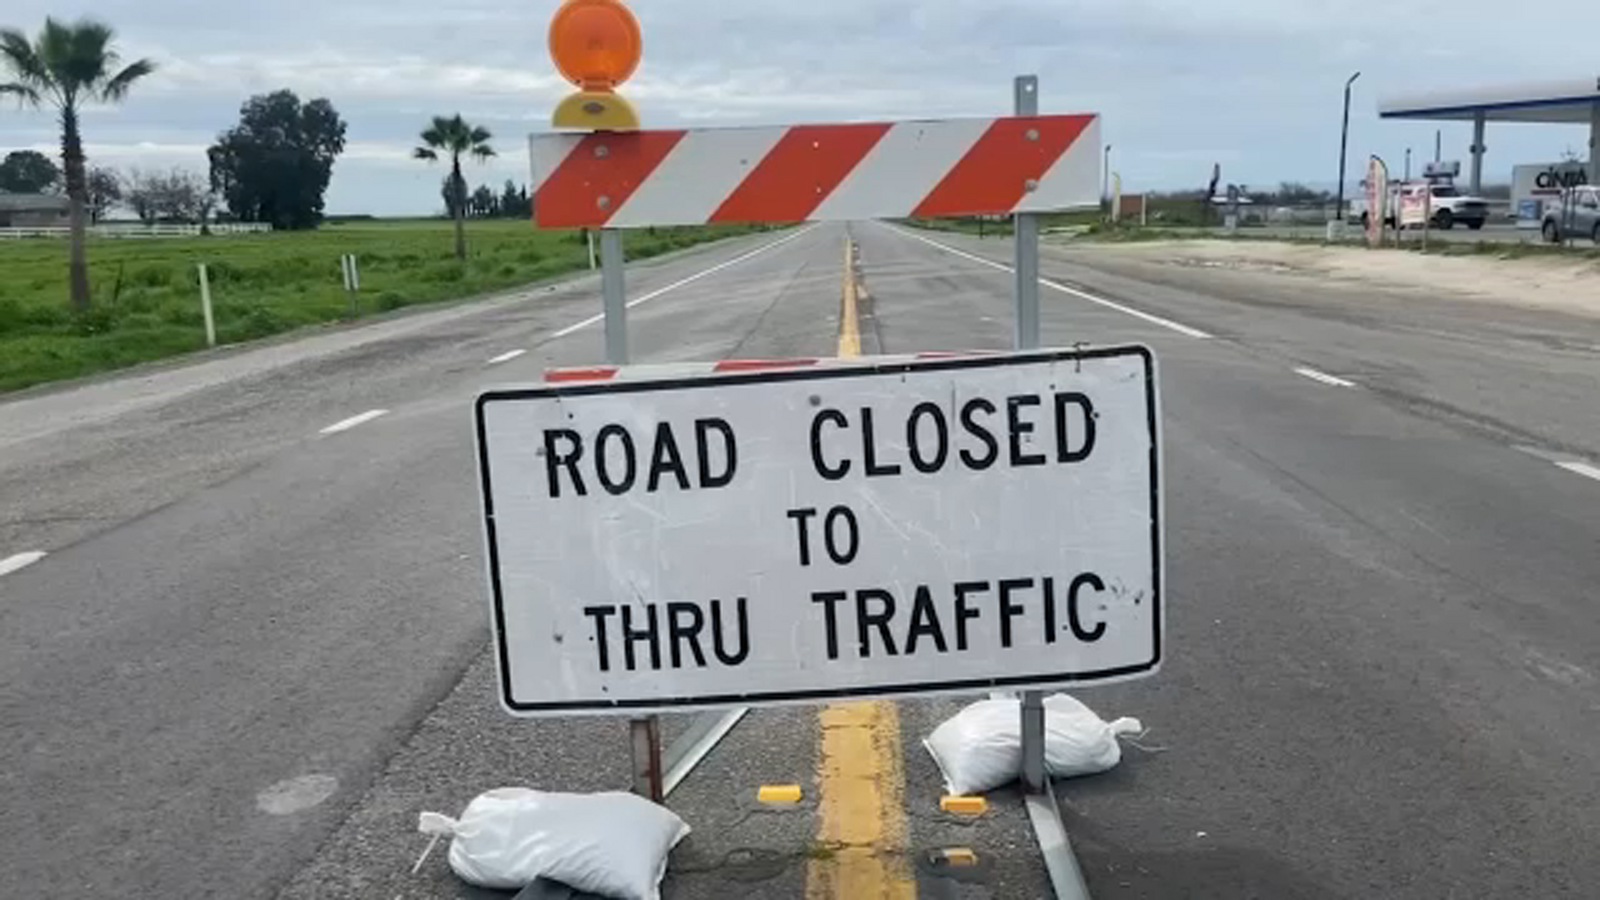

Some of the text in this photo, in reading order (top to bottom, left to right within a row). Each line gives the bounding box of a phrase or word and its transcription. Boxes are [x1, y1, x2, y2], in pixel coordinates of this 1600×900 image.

[543, 391, 1097, 498] ROAD CLOSED
[787, 506, 860, 566] TO
[584, 571, 1107, 672] THRU TRAFFIC
